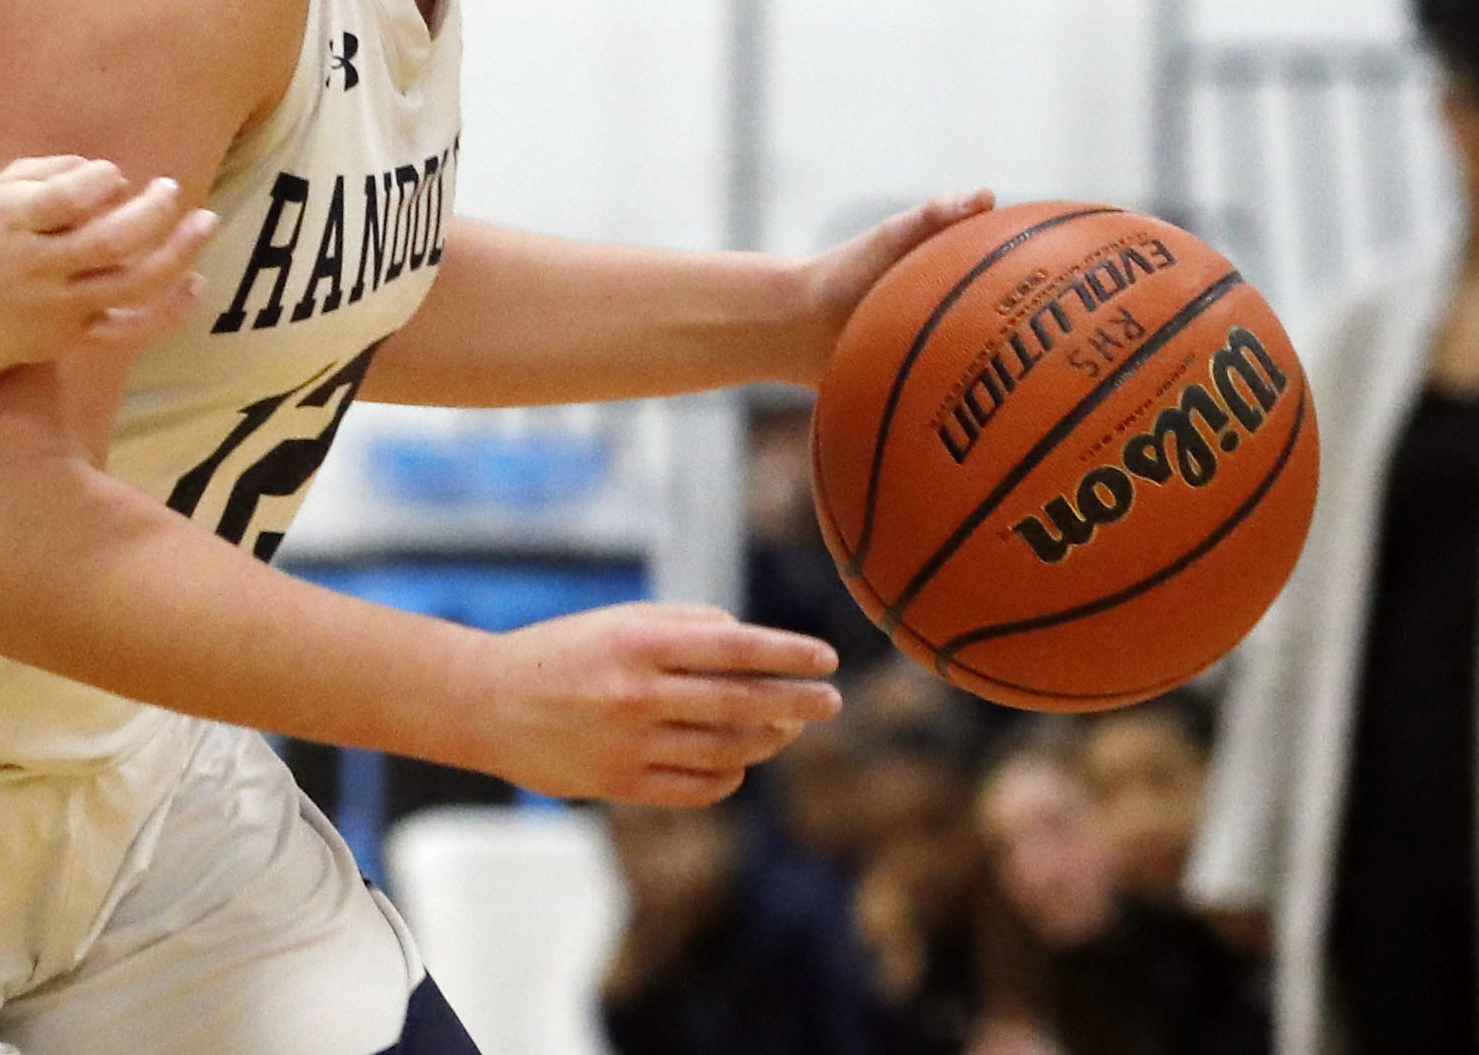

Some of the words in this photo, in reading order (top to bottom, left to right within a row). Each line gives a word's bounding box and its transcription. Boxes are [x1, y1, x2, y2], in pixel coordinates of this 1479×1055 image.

[211, 133, 459, 333] RANDOL
[165, 331, 394, 565] 12
[939, 239, 1176, 464] EVOLUTION
[1010, 325, 1290, 564] Wilson
